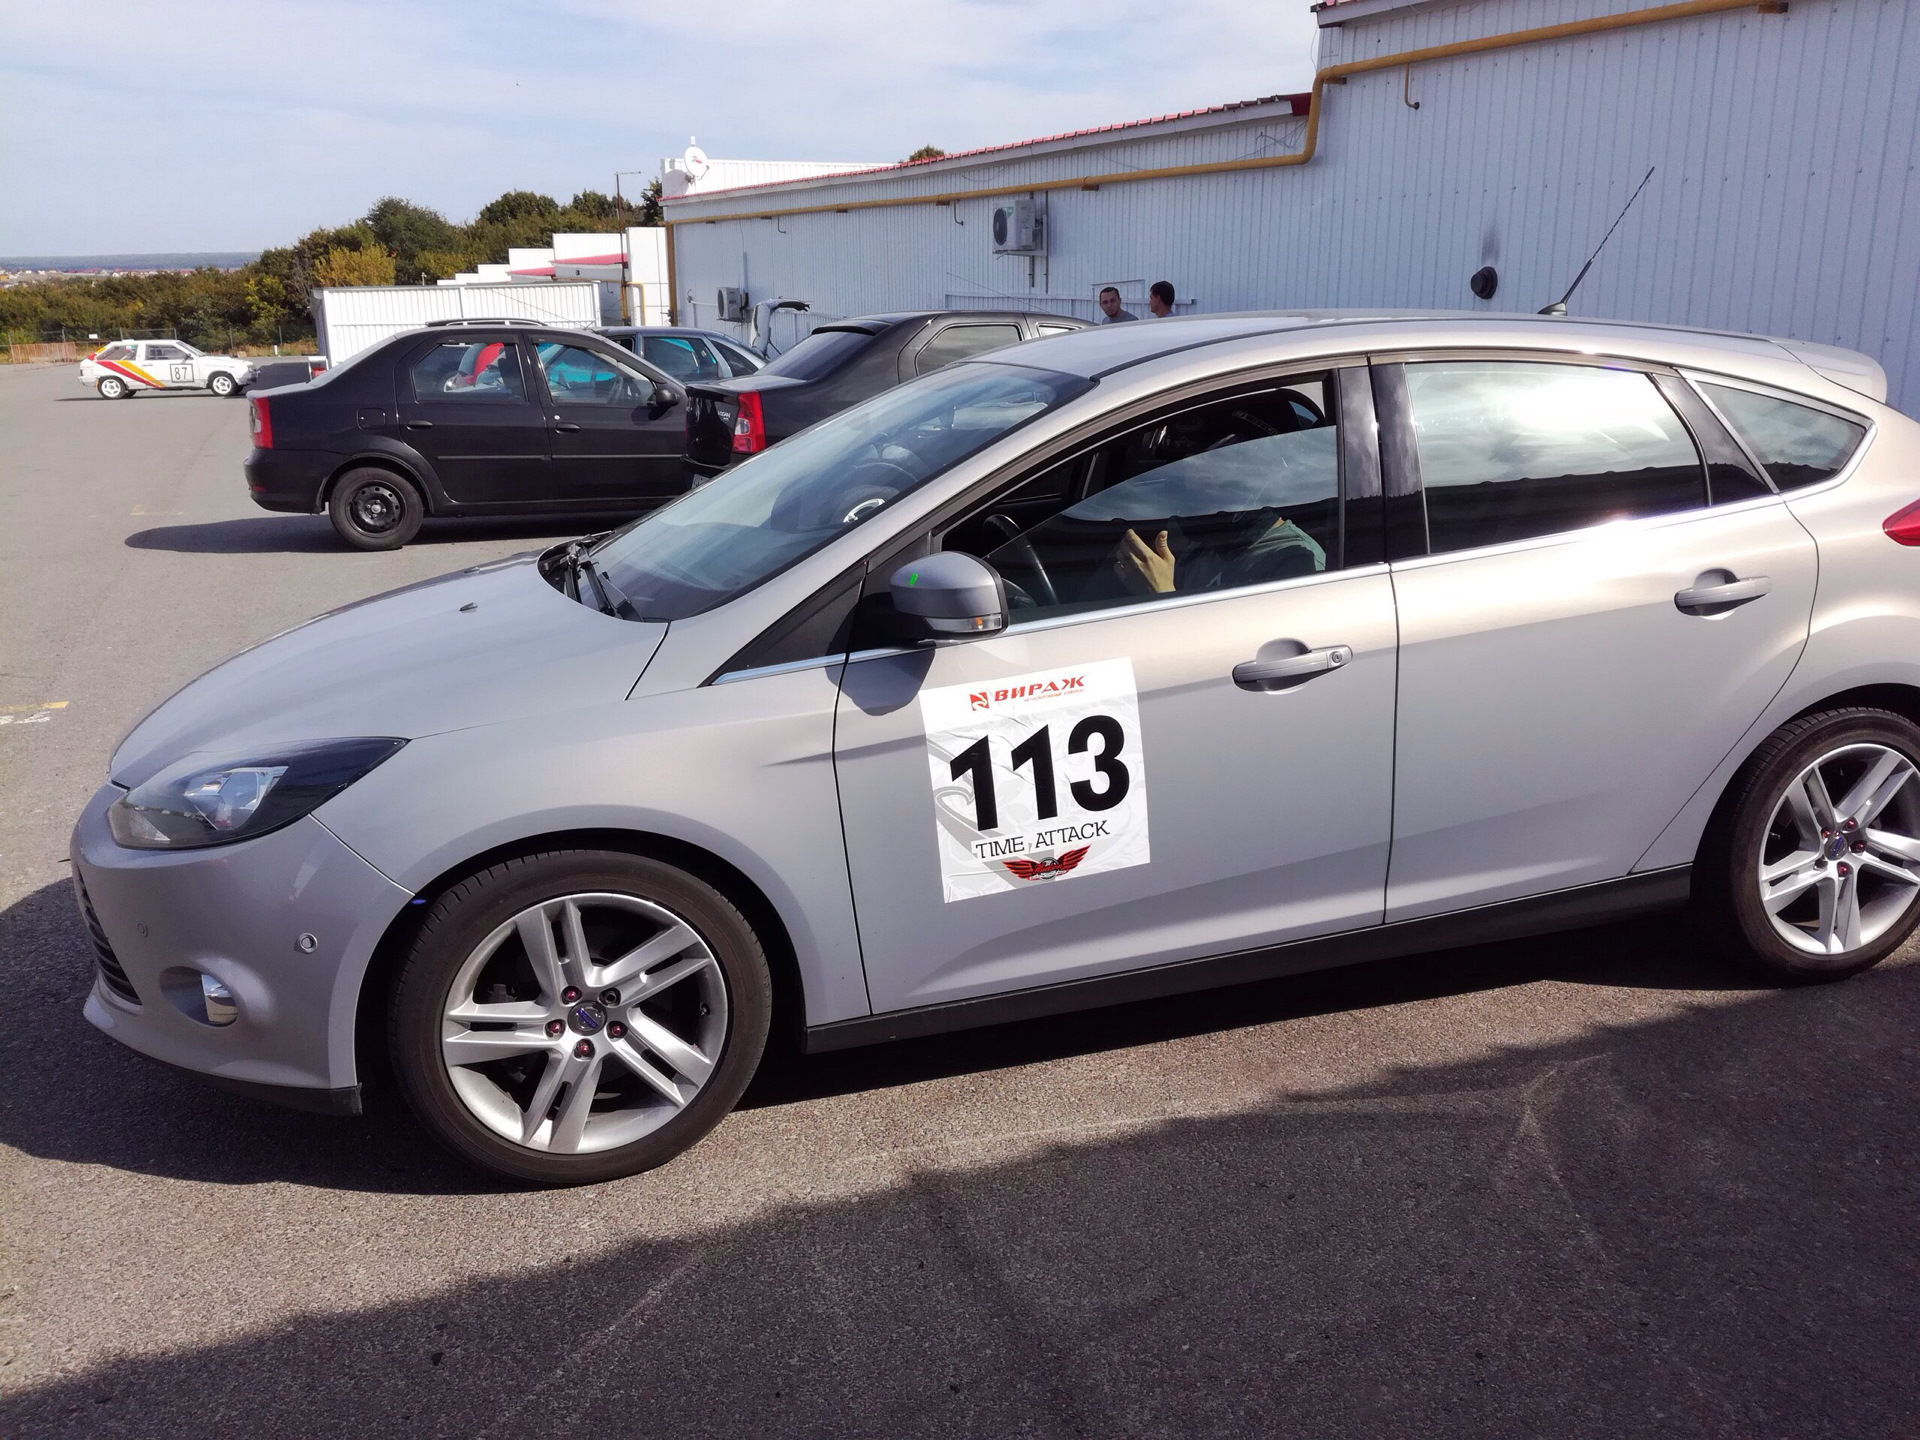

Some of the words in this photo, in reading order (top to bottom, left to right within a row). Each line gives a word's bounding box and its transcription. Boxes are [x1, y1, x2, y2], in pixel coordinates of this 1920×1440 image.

[174, 367, 188, 381] 87
[994, 676, 1085, 702] ВИРАЖ
[950, 715, 1130, 831] 113
[975, 836, 1025, 859] TIME
[1034, 820, 1110, 848] ATTACK
